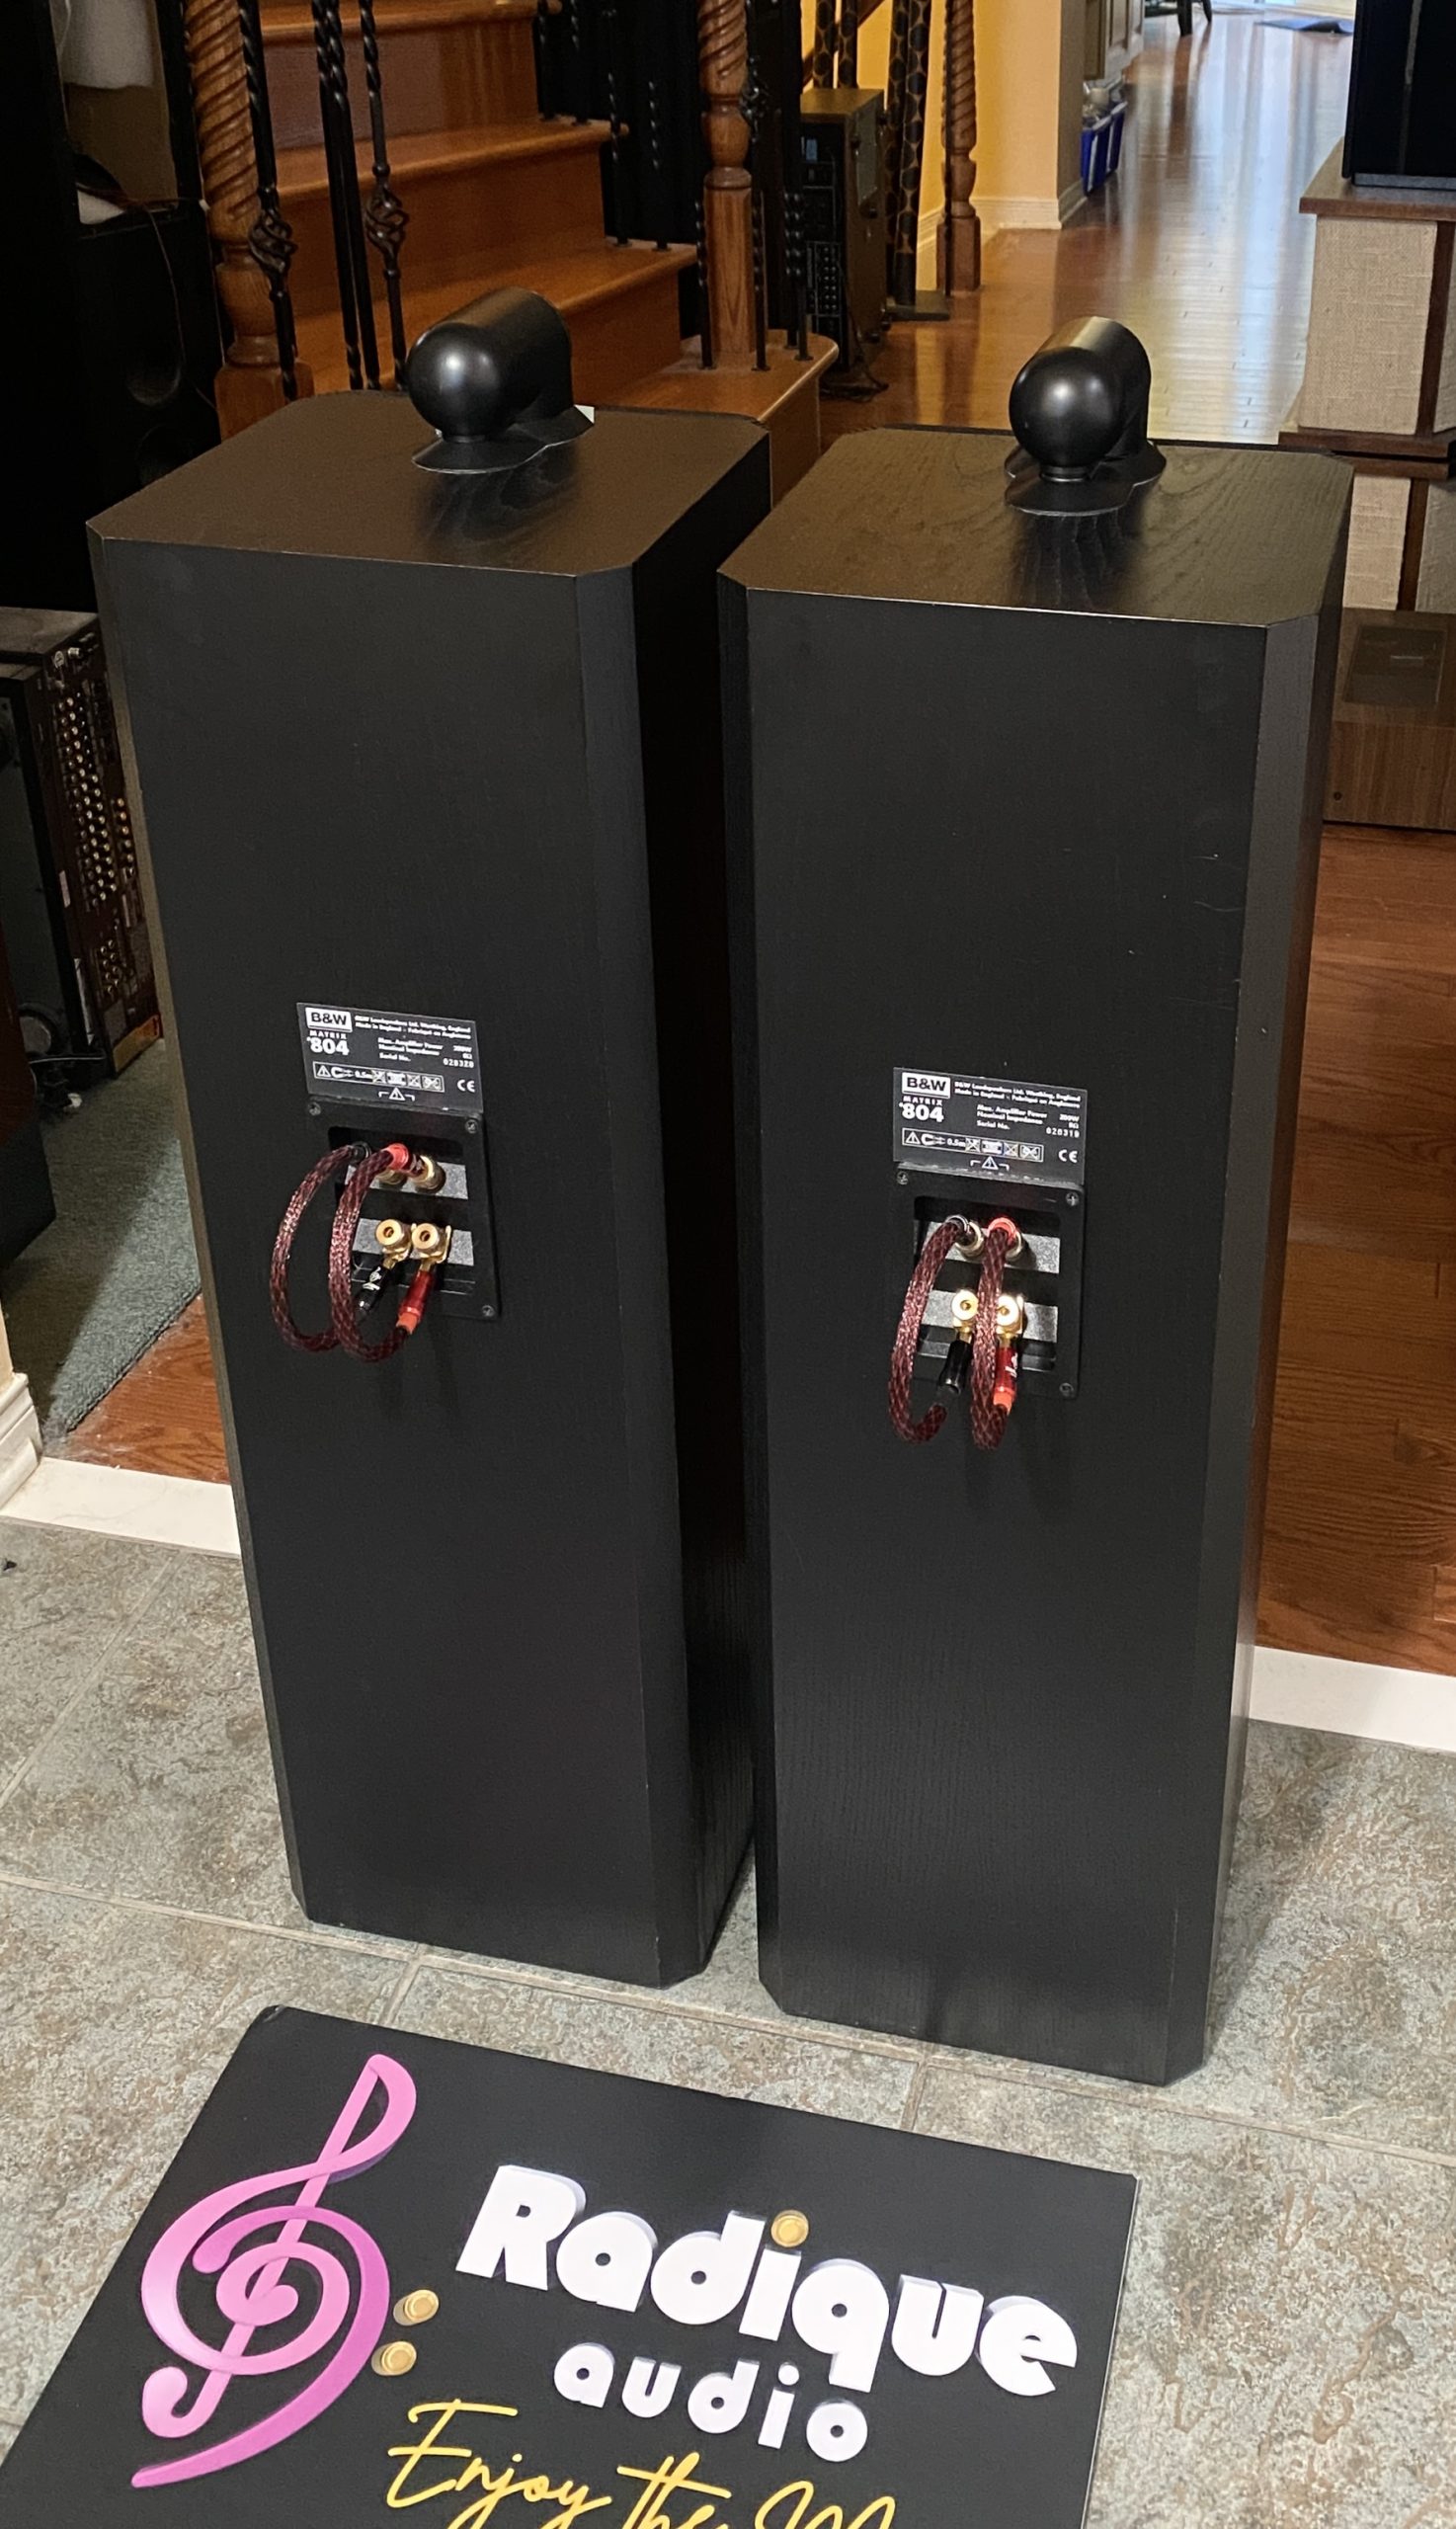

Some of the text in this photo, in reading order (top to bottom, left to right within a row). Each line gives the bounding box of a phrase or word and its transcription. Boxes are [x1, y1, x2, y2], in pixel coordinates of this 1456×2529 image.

[311, 1013, 347, 1026] B&W
[309, 1029, 348, 1039] MATRIX
[309, 1037, 350, 1056] 804
[907, 1078, 946, 1092] B&W
[903, 1096, 942, 1106] MATRIX
[902, 1102, 944, 1123] 804
[455, 2165, 1078, 2396] Radique
[553, 2342, 868, 2462] audio
[386, 2398, 612, 2529] Enjoy
